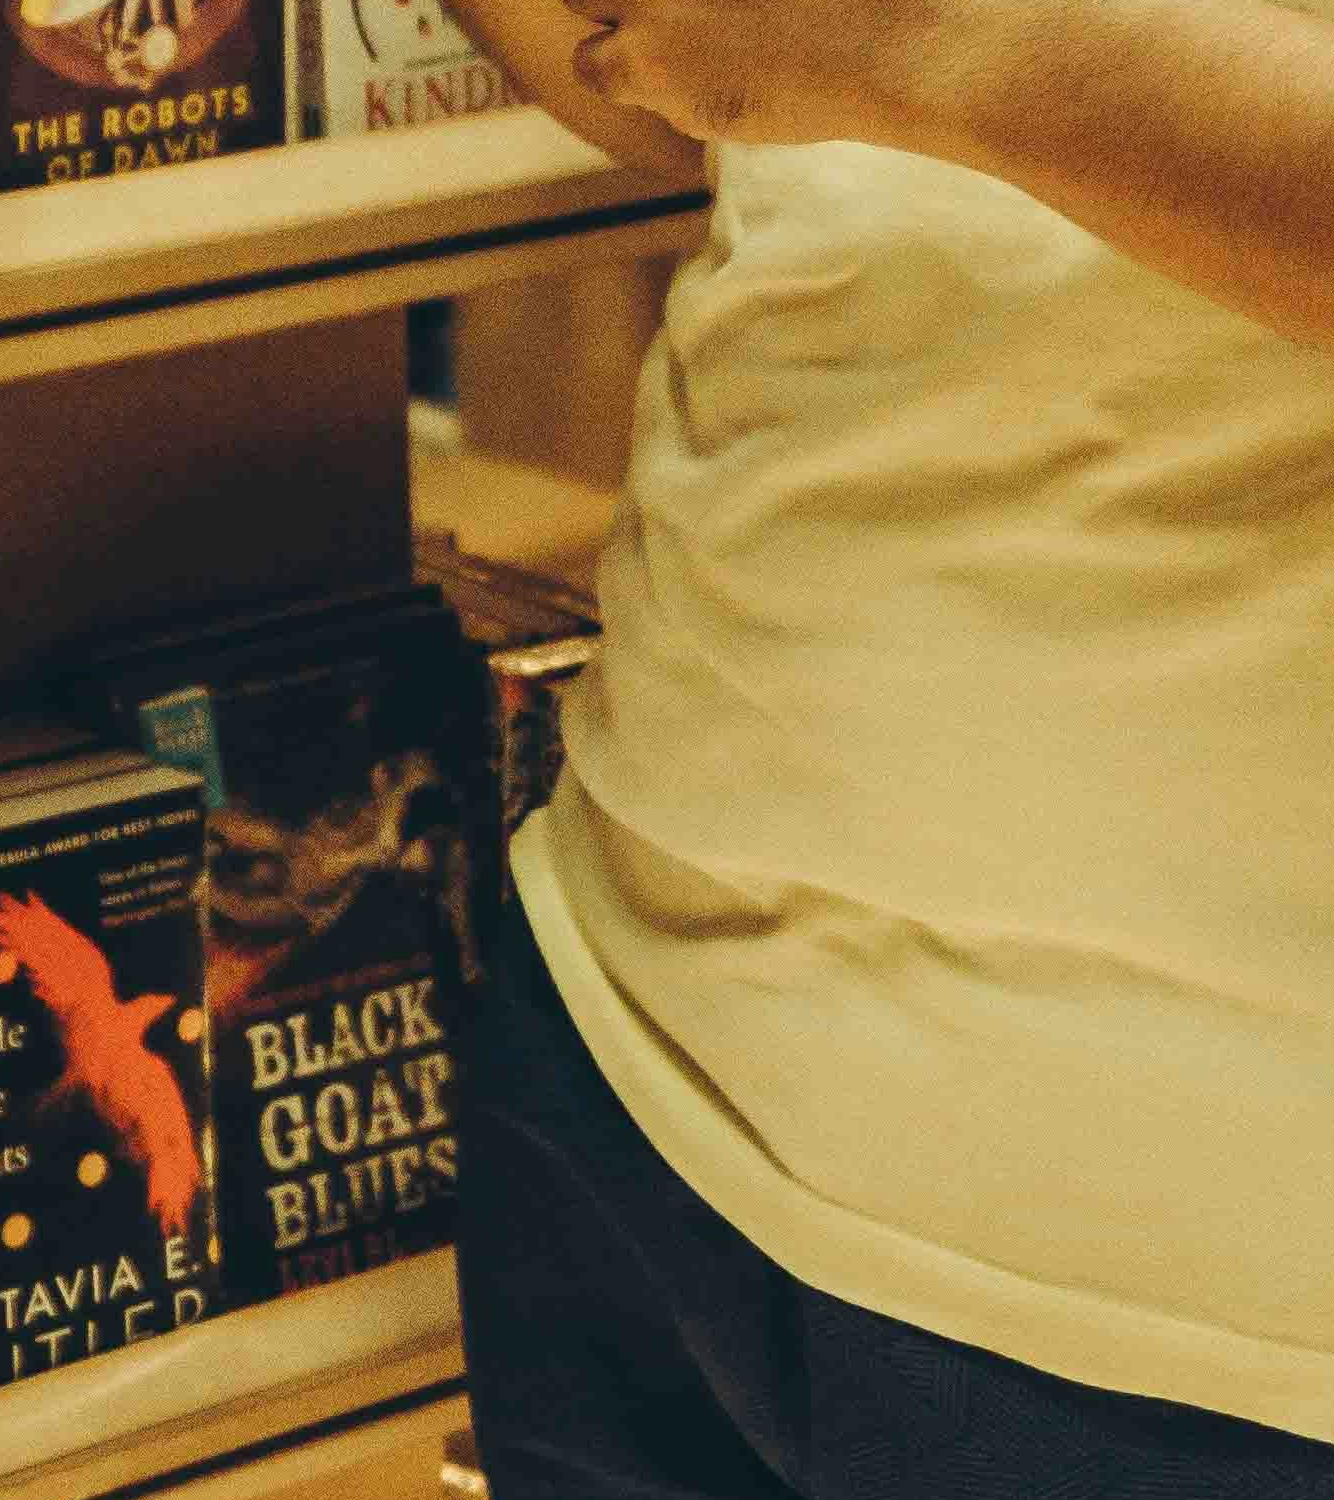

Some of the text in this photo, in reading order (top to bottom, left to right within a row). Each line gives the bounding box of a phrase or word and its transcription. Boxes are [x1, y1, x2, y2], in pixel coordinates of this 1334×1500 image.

[12, 83, 251, 154] THE ROBOTS
[47, 128, 220, 185] OF DAWN
[244, 976, 445, 1091] BLACK
[259, 1052, 455, 1174] GOAT
[266, 1135, 459, 1250] BLUES
[163, 1236, 201, 1280] E.
